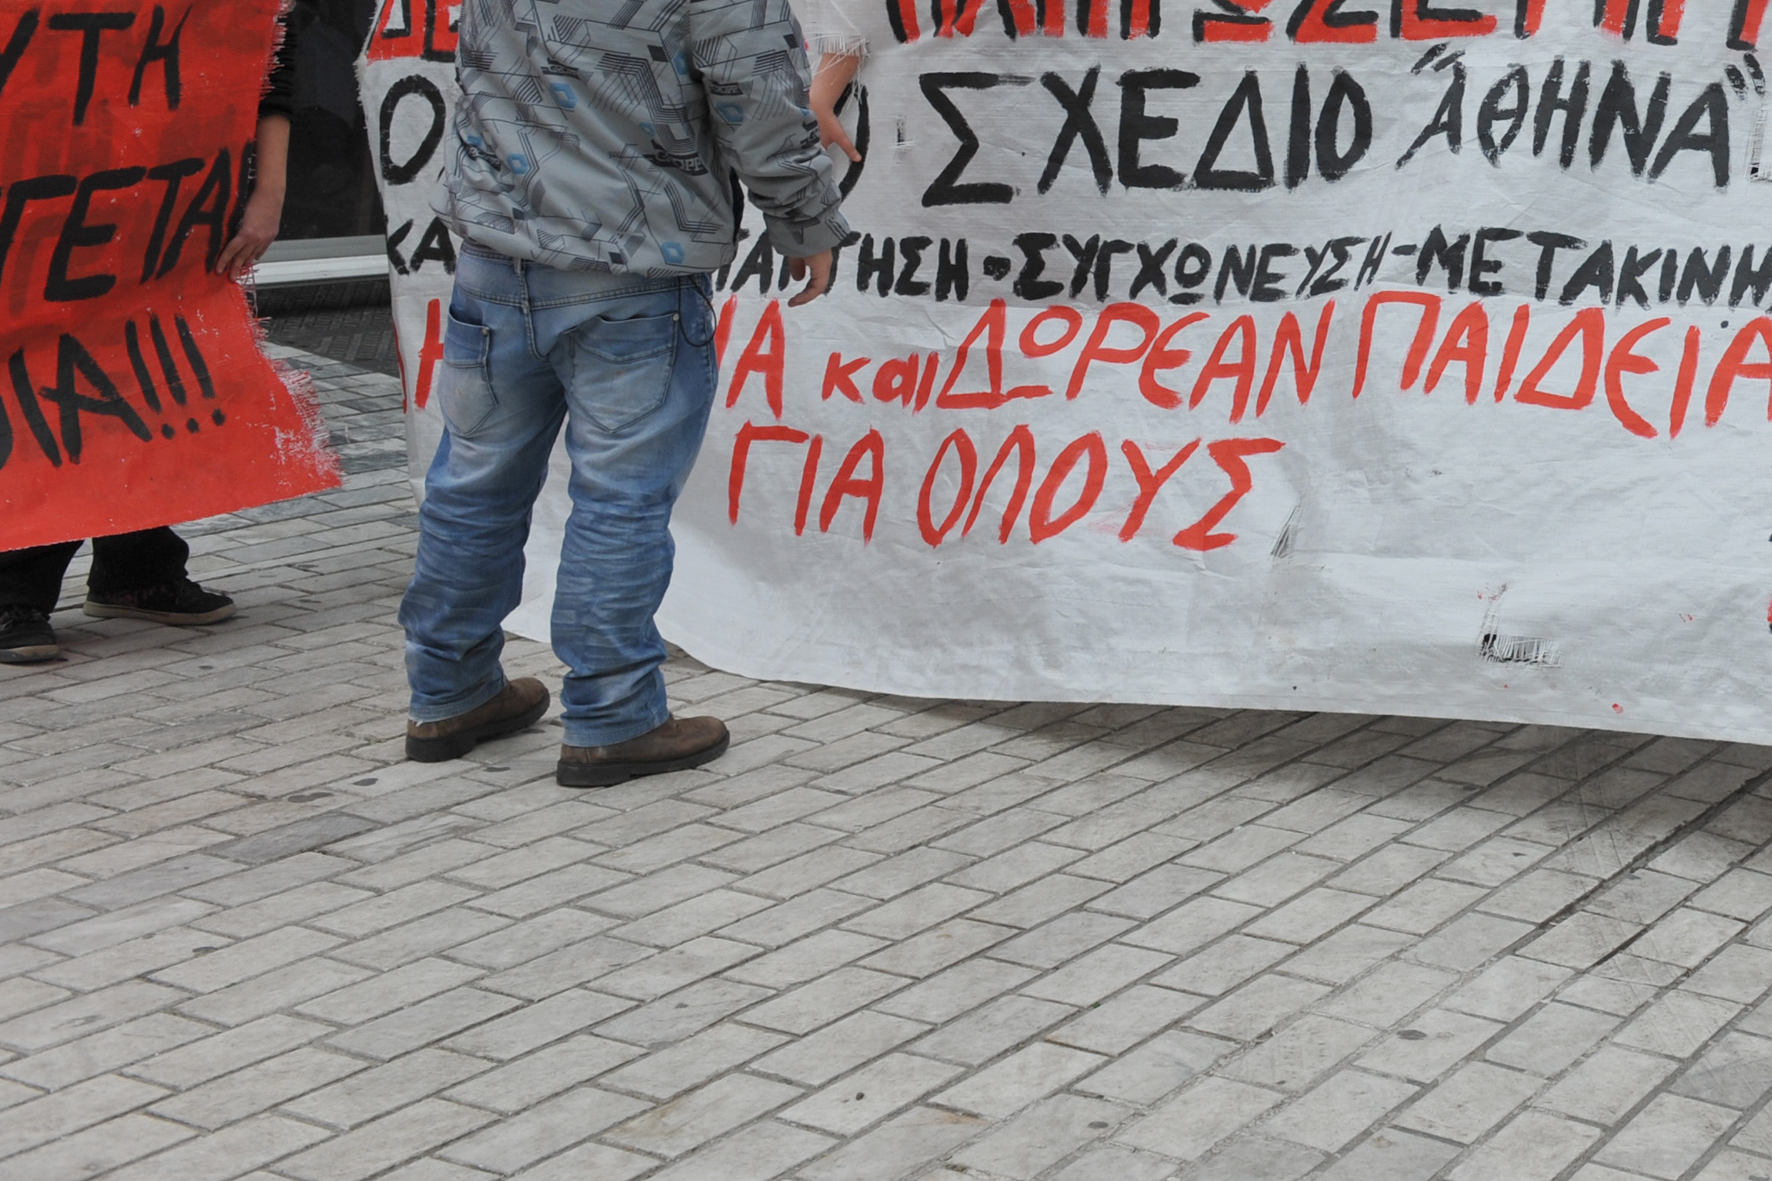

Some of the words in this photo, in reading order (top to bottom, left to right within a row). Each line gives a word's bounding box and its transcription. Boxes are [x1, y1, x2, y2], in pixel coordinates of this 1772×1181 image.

[918, 63, 1374, 208] ΣΧΕΔΙΟ
[728, 420, 885, 545] ΓΙΑ
[915, 423, 1287, 550] ΟΛΟΥΣ
